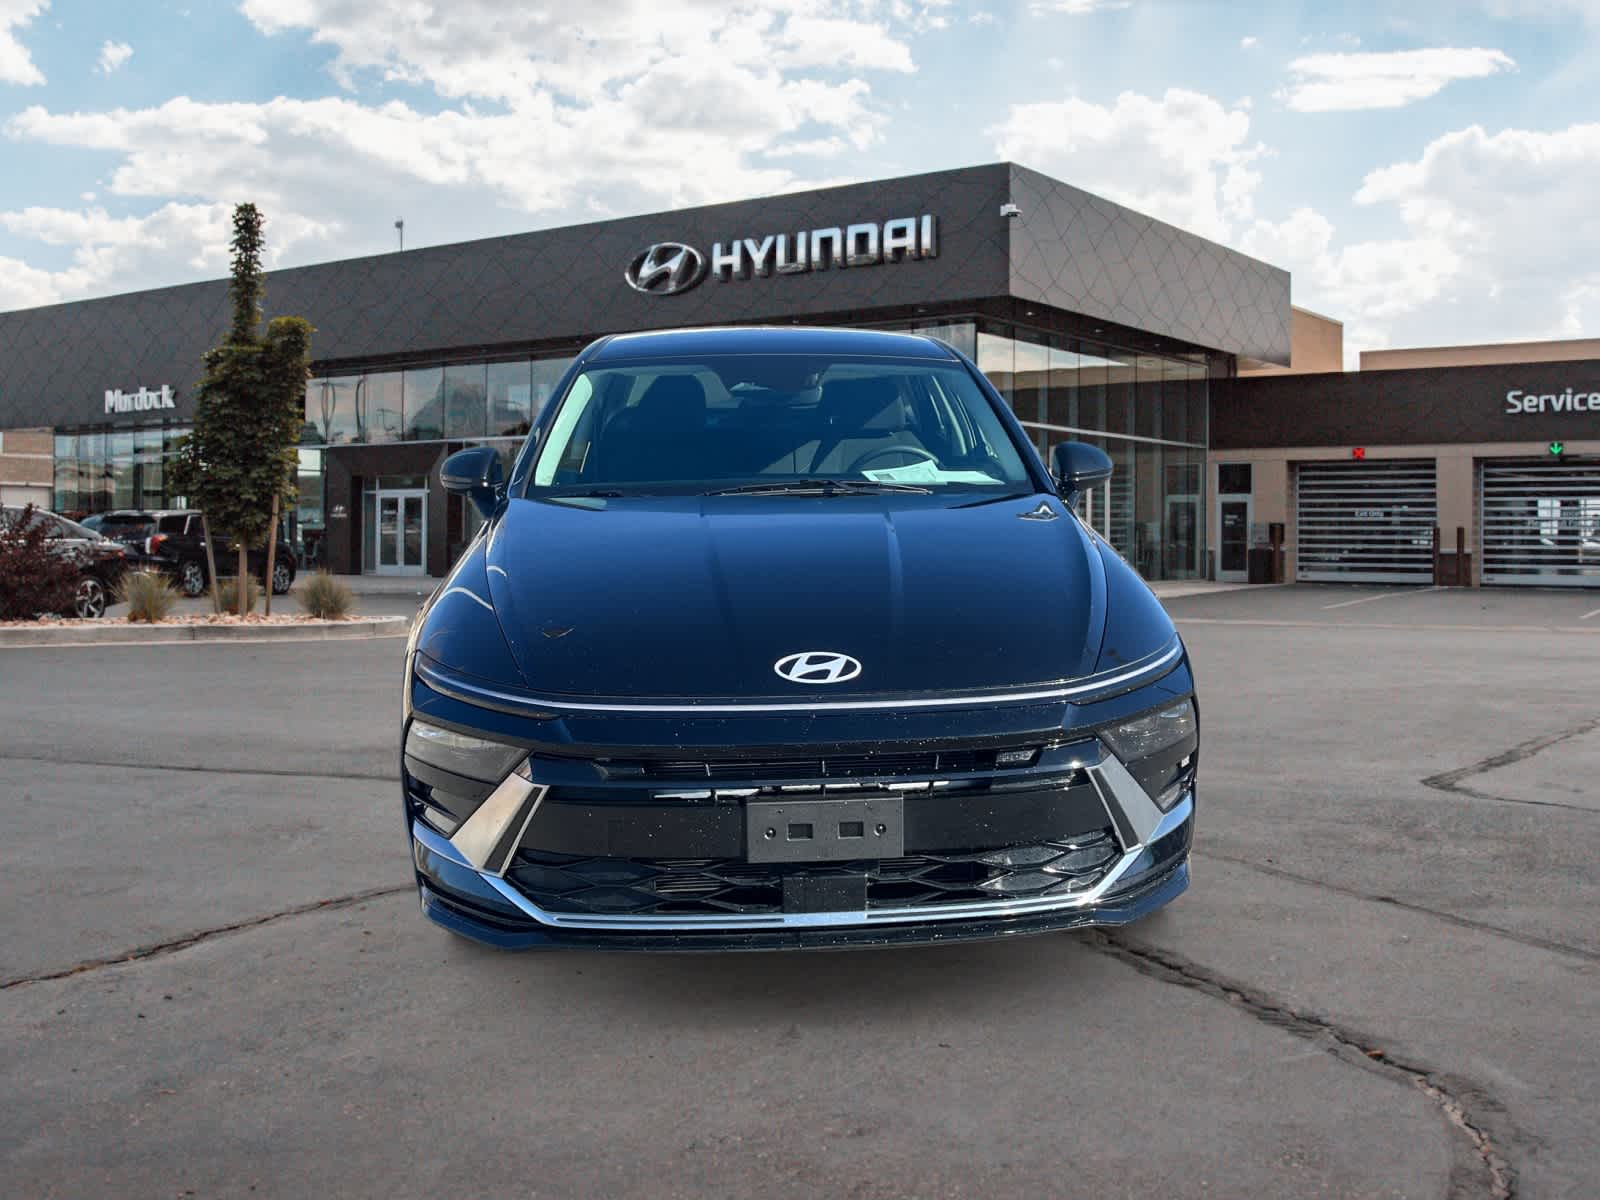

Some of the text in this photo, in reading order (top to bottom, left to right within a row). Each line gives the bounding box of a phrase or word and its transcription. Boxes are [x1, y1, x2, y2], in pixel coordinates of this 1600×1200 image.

[711, 214, 937, 282] HYUNDAI
[104, 385, 175, 414] Murdock
[1505, 388, 1600, 414] Service
